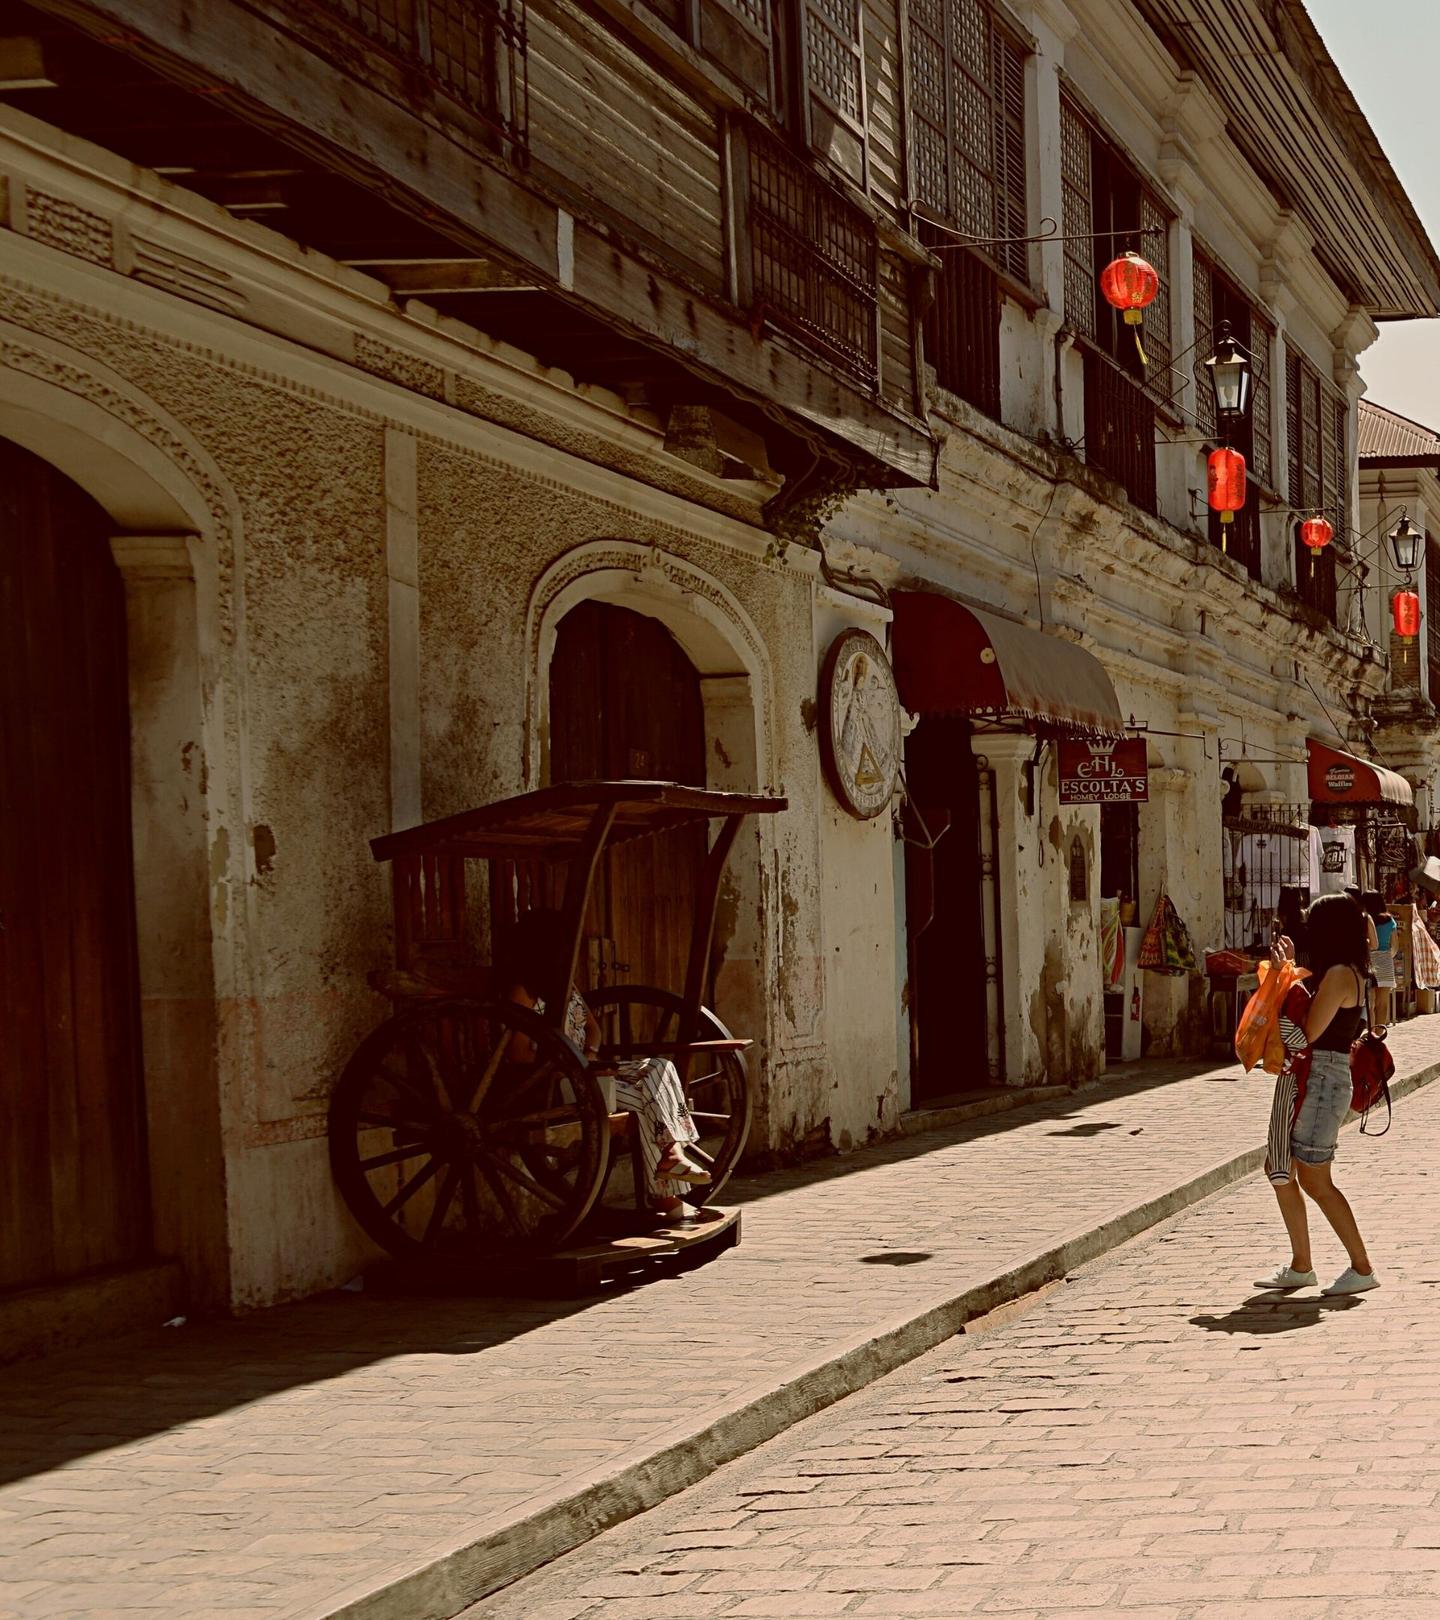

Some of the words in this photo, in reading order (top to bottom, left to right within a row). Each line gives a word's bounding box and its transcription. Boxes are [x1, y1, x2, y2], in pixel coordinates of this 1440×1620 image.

[1061, 779, 1145, 794] ESCOLTA'S
[1070, 793, 1100, 801] HOMEY
[1104, 792, 1131, 800] LODGE
